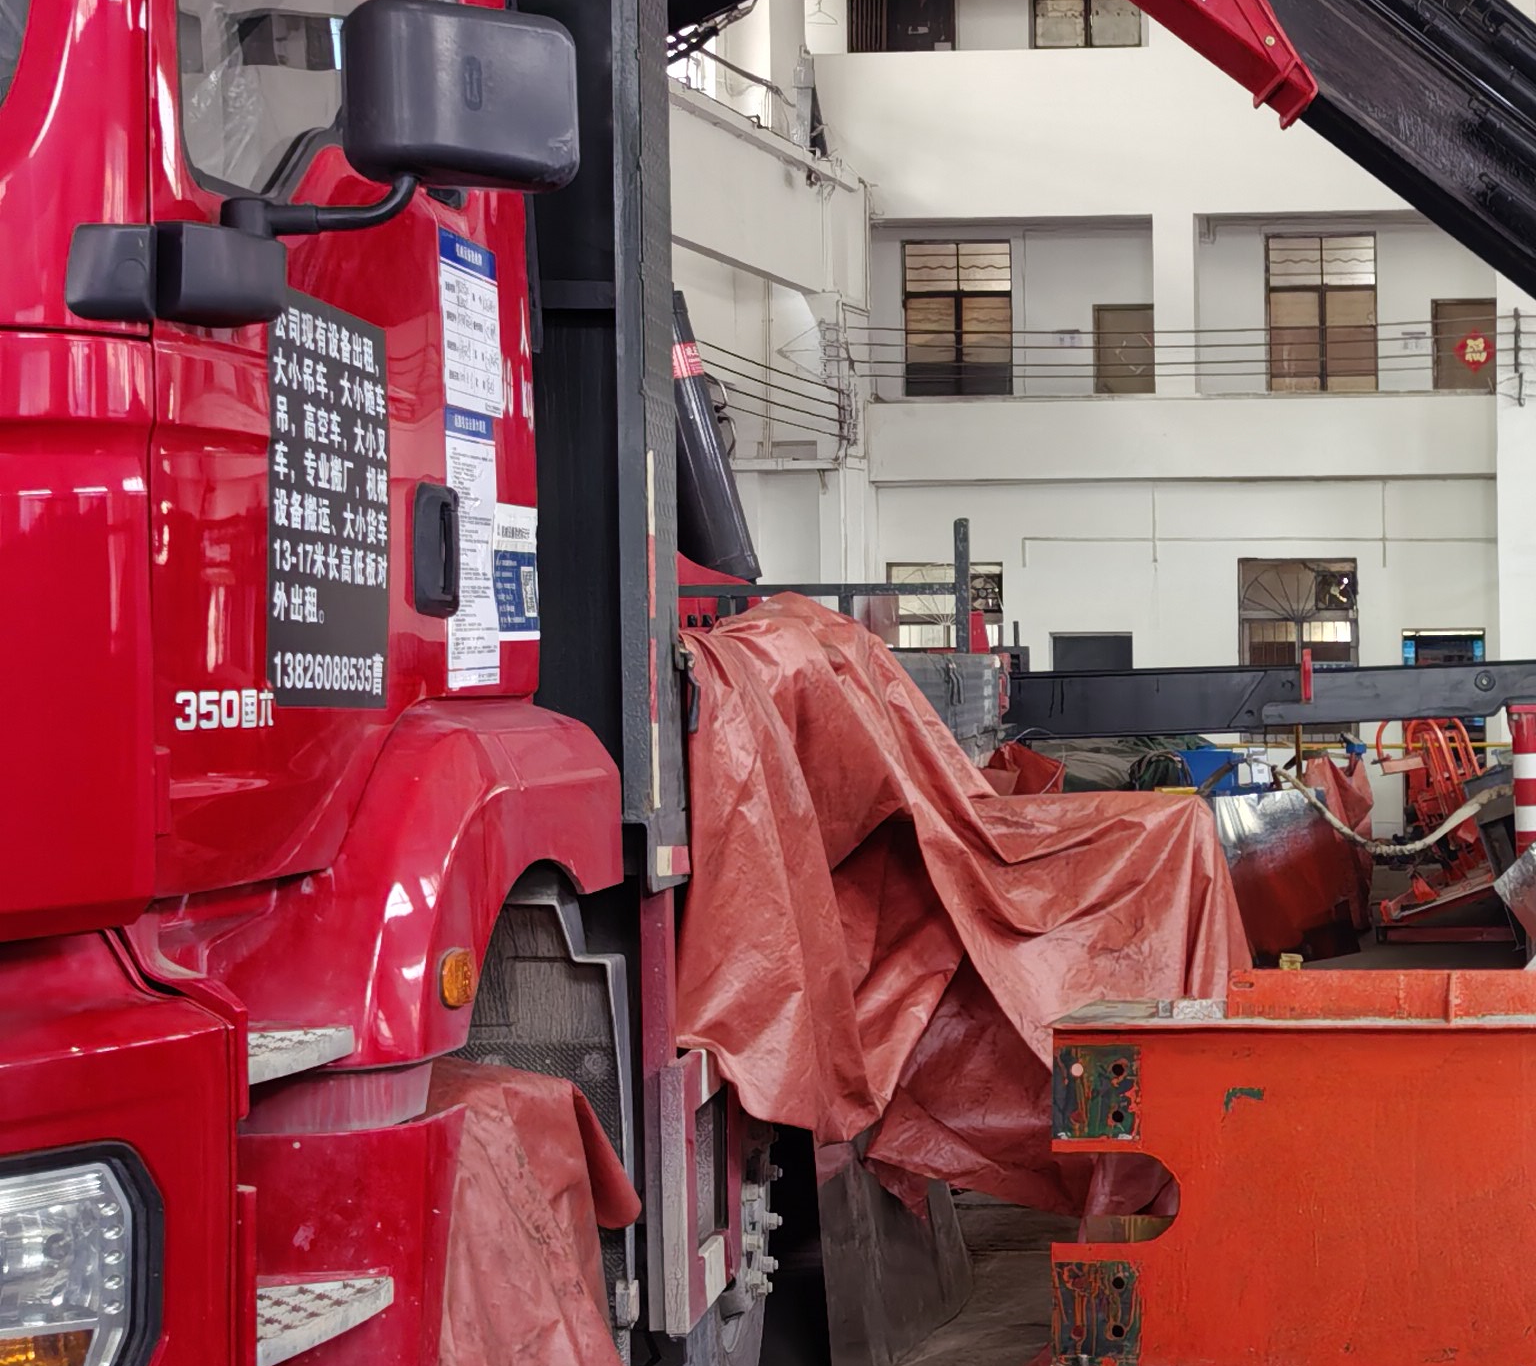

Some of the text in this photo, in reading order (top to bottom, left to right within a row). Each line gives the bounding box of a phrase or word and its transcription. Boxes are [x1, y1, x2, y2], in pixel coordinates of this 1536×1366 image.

[273, 538, 388, 590] 13-17米长高低板对
[272, 581, 325, 625] 外出租。
[273, 650, 385, 697] 13826088535曹
